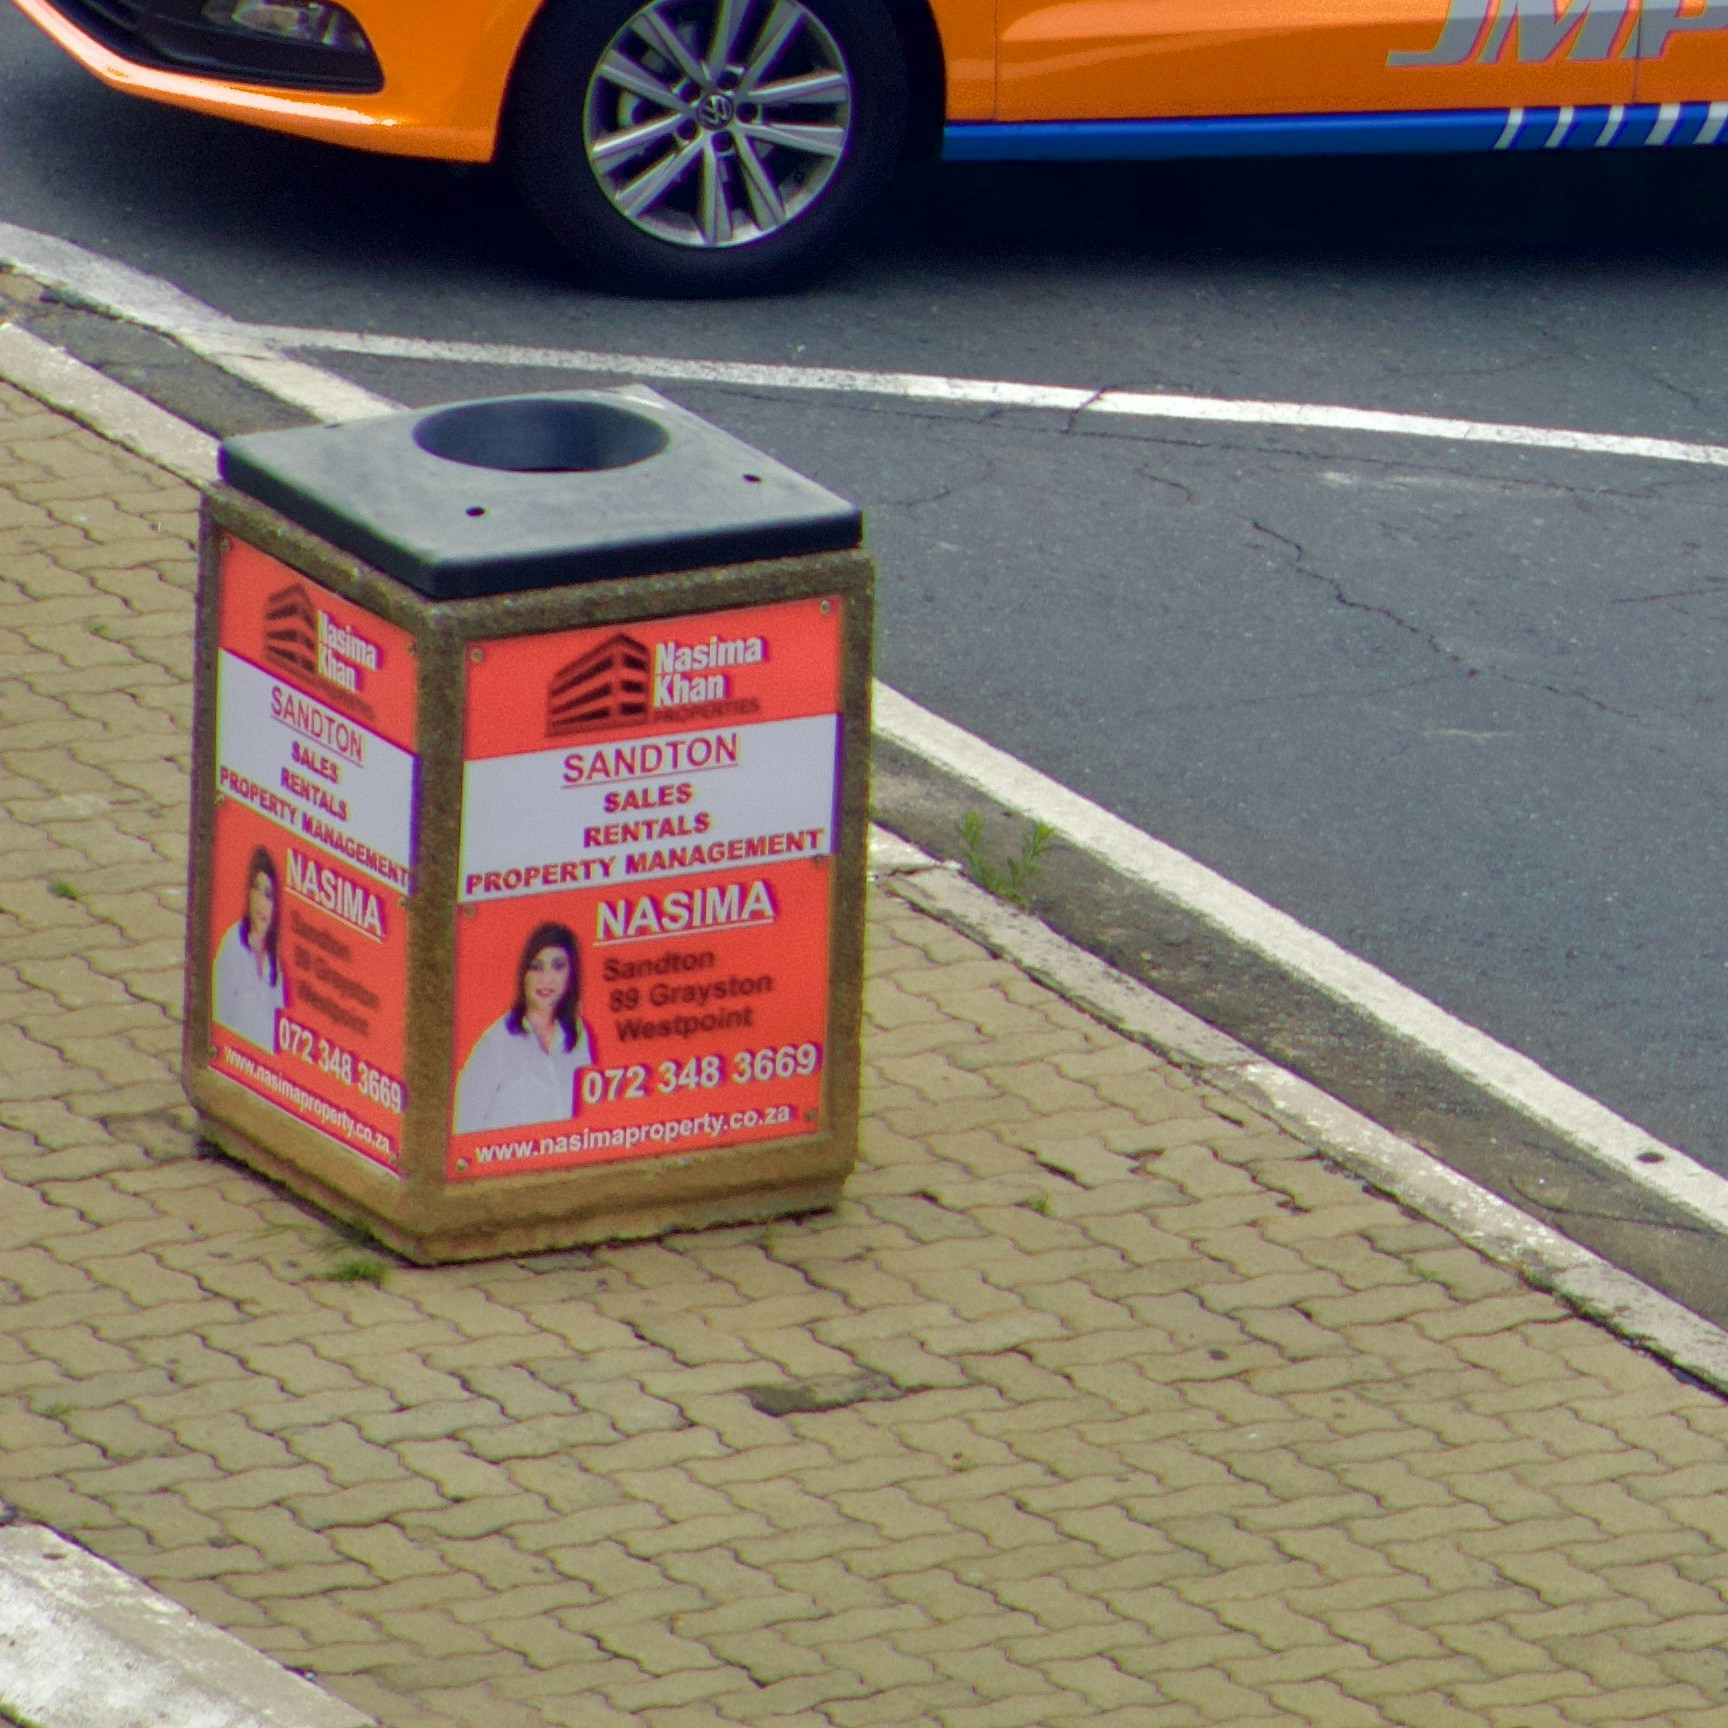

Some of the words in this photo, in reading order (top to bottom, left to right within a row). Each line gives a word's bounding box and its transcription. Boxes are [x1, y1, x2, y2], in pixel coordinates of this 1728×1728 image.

[655, 635, 764, 673] Nasima
[654, 674, 726, 709] Khan
[271, 686, 363, 762] SANDTON
[292, 742, 338, 784] SALES
[562, 733, 738, 783] SANDTON
[281, 767, 347, 821] RENTALS
[604, 783, 692, 813] SALES
[220, 766, 297, 825] PROPERTY
[302, 812, 409, 886] MANAGEMENT
[583, 812, 711, 848] RENTALS
[465, 856, 616, 895] PROPERTY
[625, 829, 824, 874] MANAGEMENT
[286, 848, 383, 937] NASIMA
[596, 880, 774, 940] NASIMA
[603, 949, 716, 981] Sandton
[650, 974, 773, 1008] Grayston
[616, 1007, 755, 1042] Westpoint
[279, 1018, 315, 1064] 072
[318, 1040, 352, 1086] 348
[357, 1062, 401, 1114] 3669
[583, 1064, 646, 1104] 072
[658, 1056, 720, 1094] 348
[732, 1042, 817, 1084] 3669
[224, 1044, 391, 1153] www.nasimaproperty.co.za
[476, 1105, 791, 1163] www.nasimaproperty.co.za
